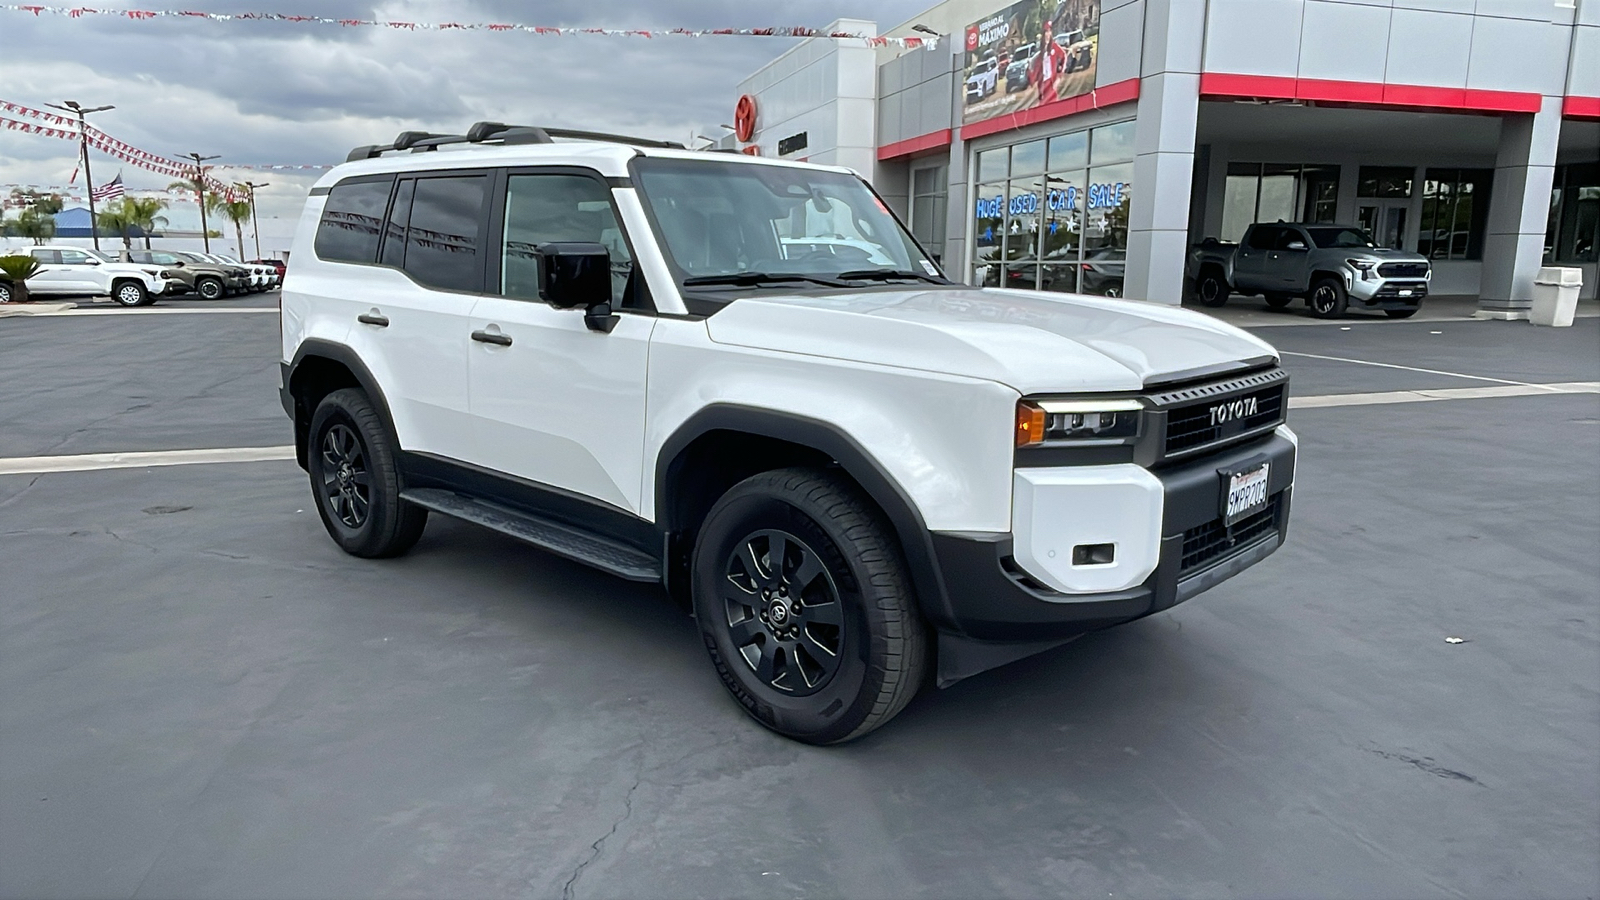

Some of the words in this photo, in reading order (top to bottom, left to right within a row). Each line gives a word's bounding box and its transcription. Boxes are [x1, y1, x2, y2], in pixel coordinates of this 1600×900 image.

[978, 22, 1010, 48] MÁXIMO
[976, 195, 1003, 218] HUGE
[1009, 193, 1038, 215] USED
[1049, 186, 1077, 210] CAR
[1088, 182, 1124, 209] SALE
[1209, 396, 1258, 426] TOYOTA
